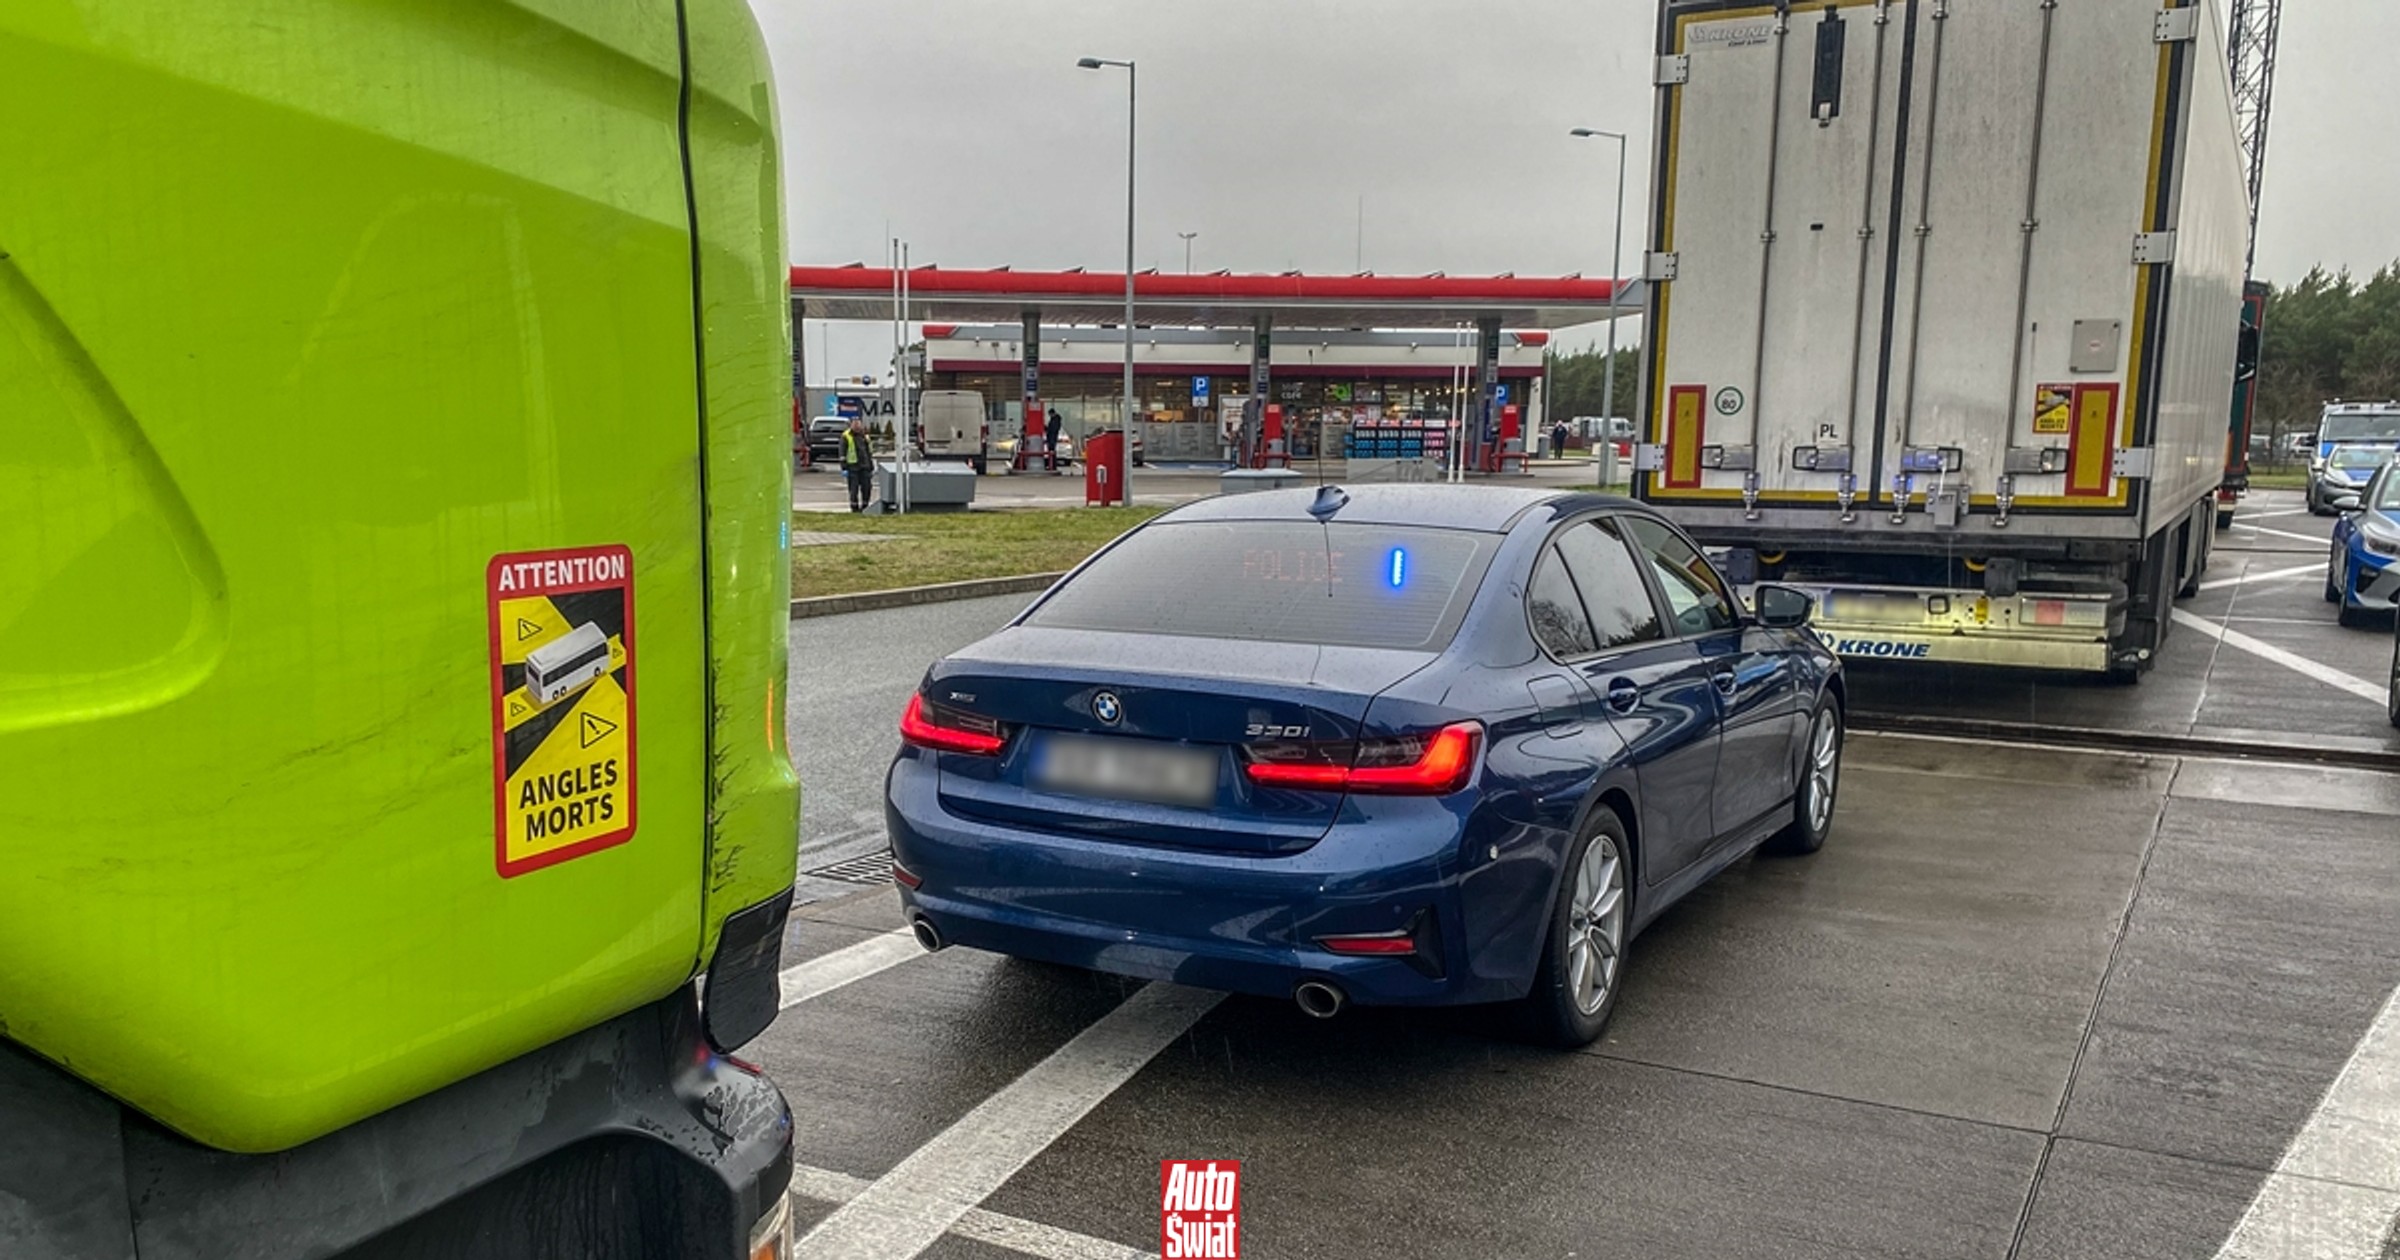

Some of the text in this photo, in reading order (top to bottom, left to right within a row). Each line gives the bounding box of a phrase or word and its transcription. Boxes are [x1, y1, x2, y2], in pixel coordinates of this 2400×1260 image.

[1709, 25, 1770, 41] KRONE
[1196, 377, 1206, 391] P
[1722, 398, 1737, 410] 80
[1820, 424, 1838, 438] PL
[499, 554, 626, 591] ATTENTION
[1837, 639, 1932, 657] KRONE
[519, 759, 618, 810] ANGLES
[526, 793, 614, 842] MORTS
